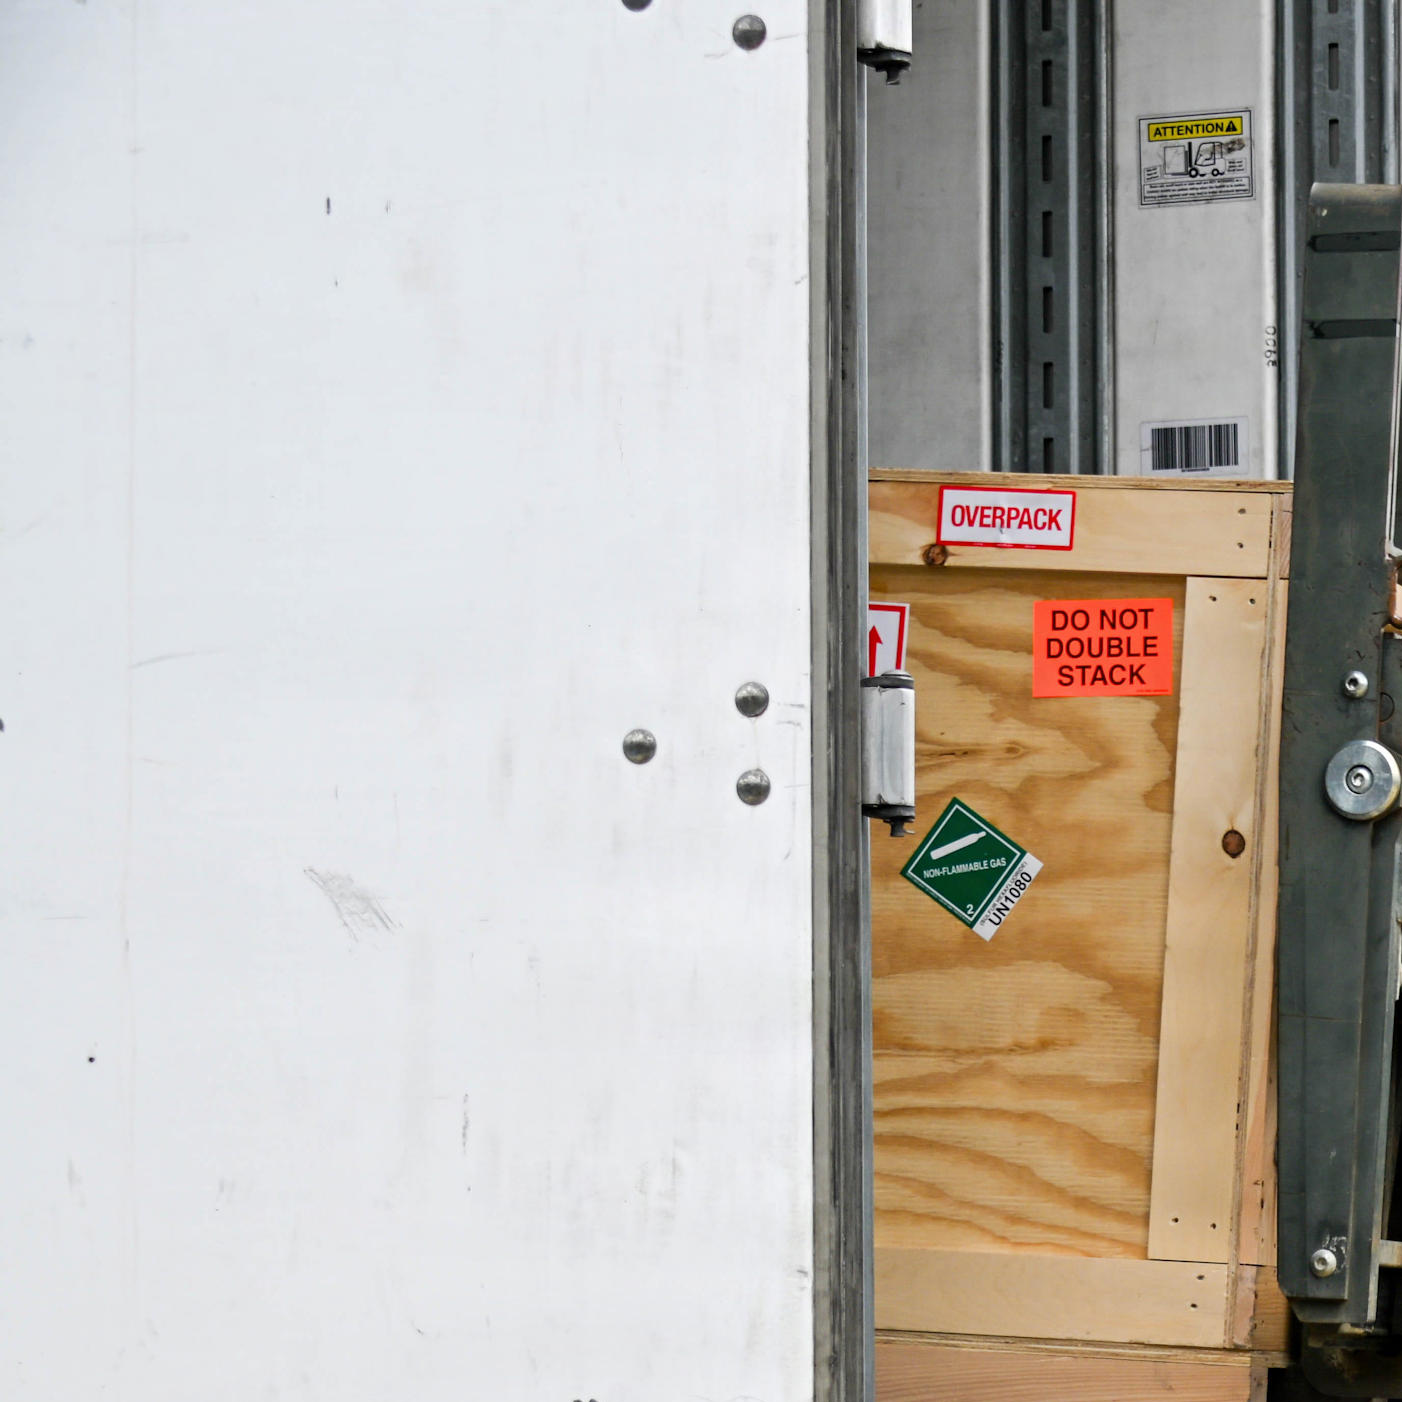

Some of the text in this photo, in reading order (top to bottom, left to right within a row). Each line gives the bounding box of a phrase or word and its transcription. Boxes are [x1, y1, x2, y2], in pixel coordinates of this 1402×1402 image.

[1153, 121, 1224, 138] ATTENTION
[951, 504, 1062, 531] OVERPACK
[1052, 608, 1154, 631] DO NOT
[1047, 636, 1158, 659] DOUBLE
[1058, 663, 1146, 687] STACK
[923, 857, 1007, 879] NON-FLAMMABLE GAS
[966, 903, 975, 915] 2
[989, 871, 1032, 927] UN1080
